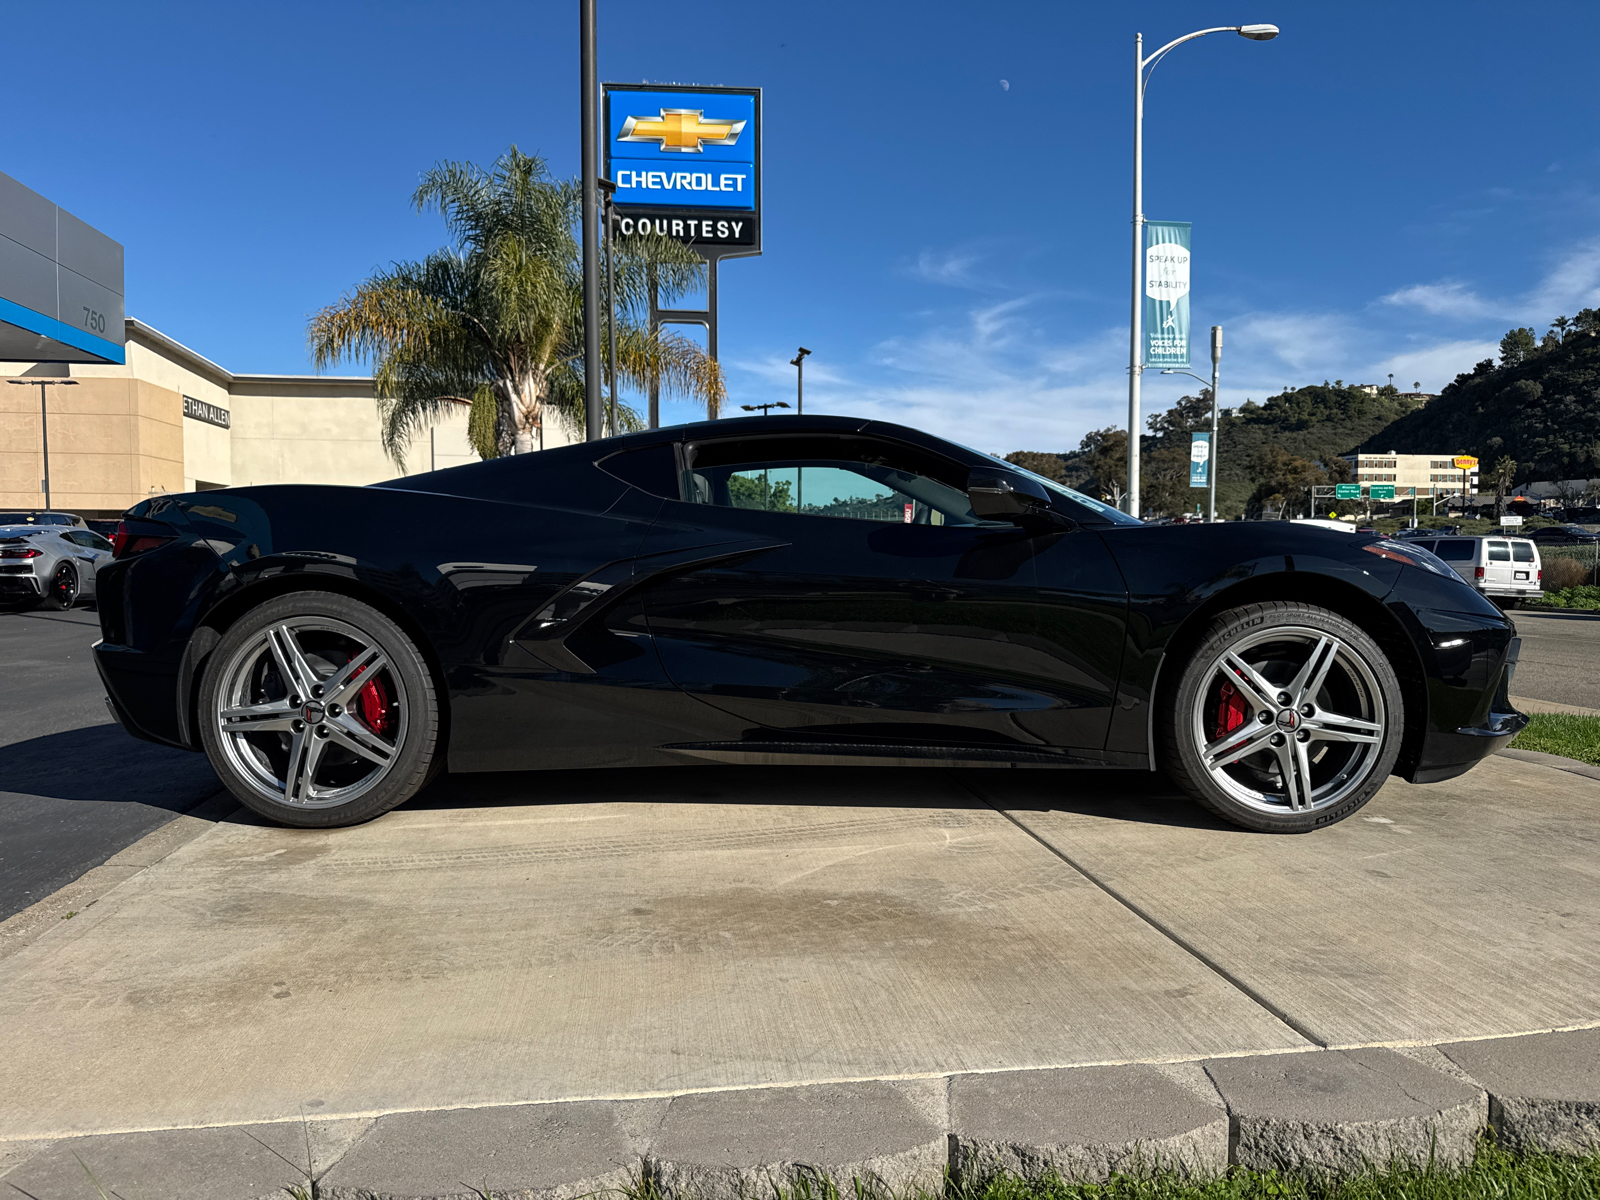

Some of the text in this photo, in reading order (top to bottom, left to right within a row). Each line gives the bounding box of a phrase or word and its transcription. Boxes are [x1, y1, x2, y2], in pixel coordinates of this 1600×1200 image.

[616, 170, 746, 192] CHEVROLET
[621, 217, 743, 239] COURTESY
[1149, 255, 1188, 264] SPEAK UP
[1149, 280, 1187, 289] STABILITY
[82, 305, 106, 334] 750
[1150, 339, 1187, 347] VOICES FOR
[1150, 347, 1187, 355] CHILDREN
[183, 396, 230, 425] ETHAN ALLEN
[1455, 458, 1477, 466] Denny's
[1212, 617, 1262, 649] MICHELIN
